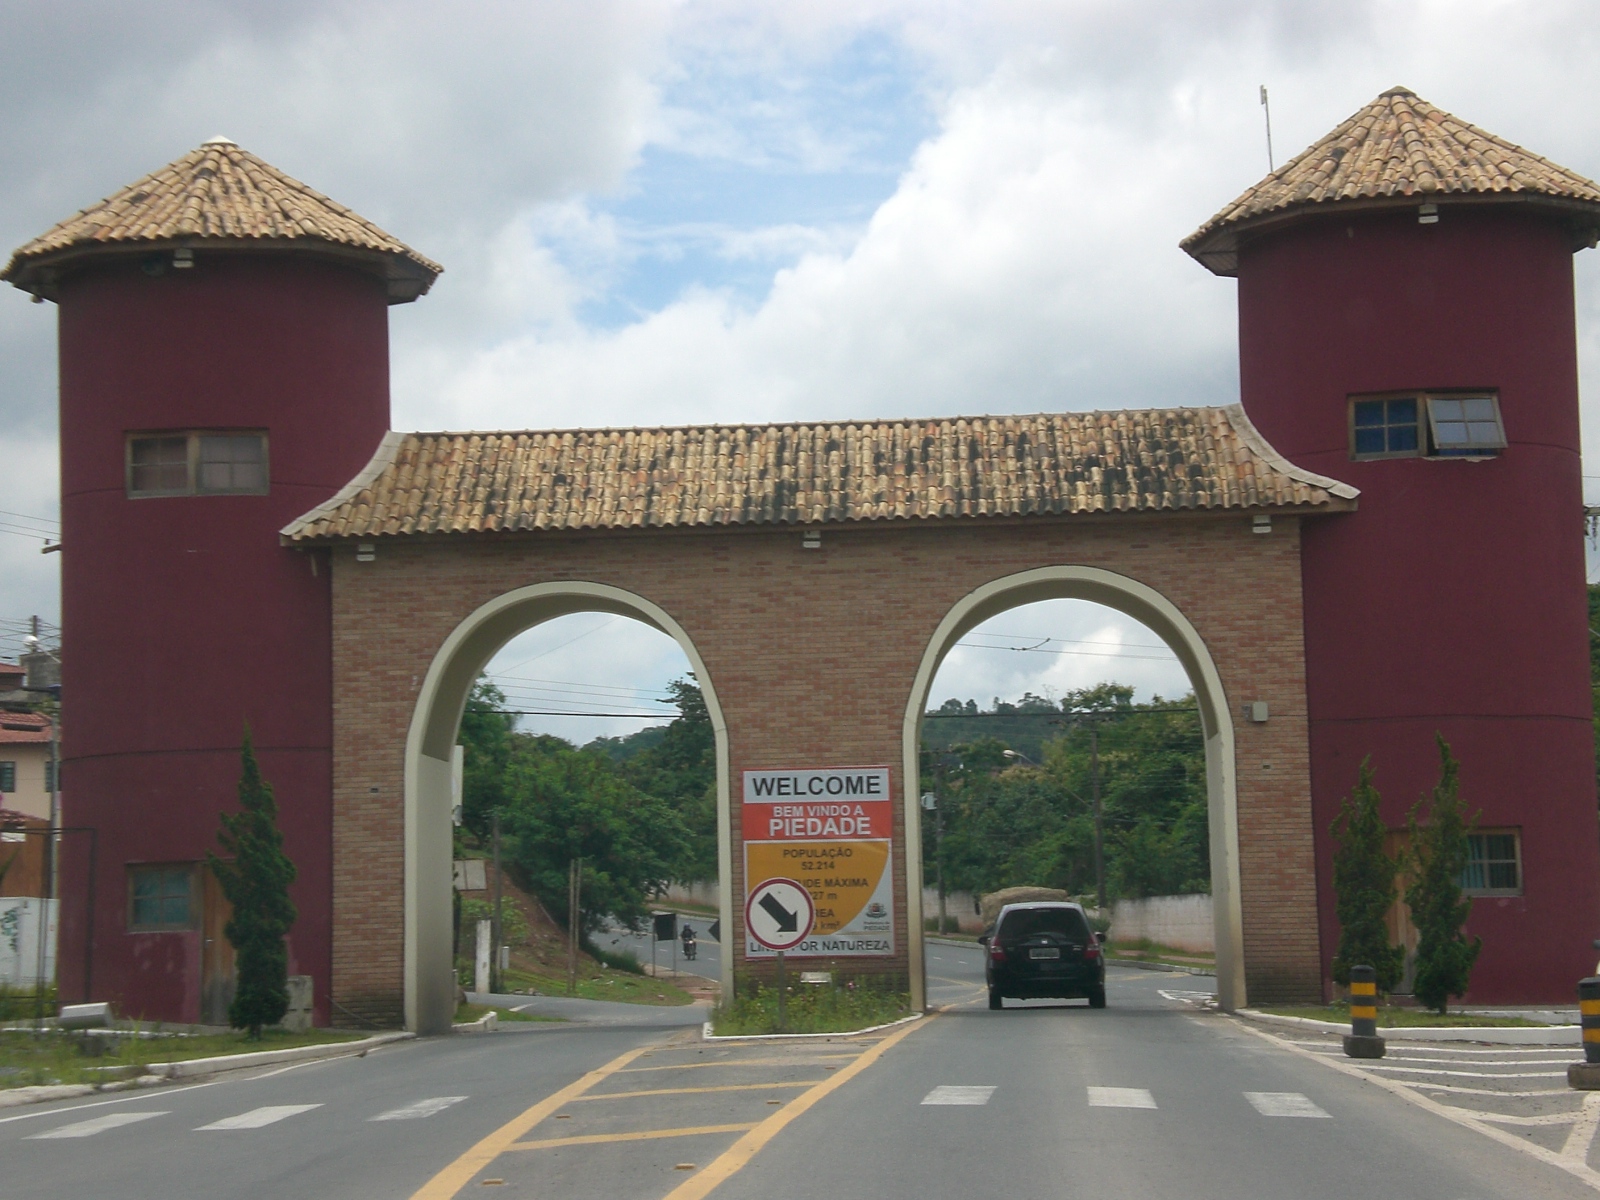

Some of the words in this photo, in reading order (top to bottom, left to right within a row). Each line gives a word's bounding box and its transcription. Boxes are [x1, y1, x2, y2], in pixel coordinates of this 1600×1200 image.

[753, 775, 880, 796] WELCOME
[773, 806, 803, 817] BEM
[807, 805, 851, 816] VINDO
[853, 805, 864, 816] A
[769, 817, 871, 836] PIEDADE
[783, 847, 853, 860] POPULAÇÃO
[801, 861, 835, 870] 52.214
[822, 940, 890, 951] NATUREZA
